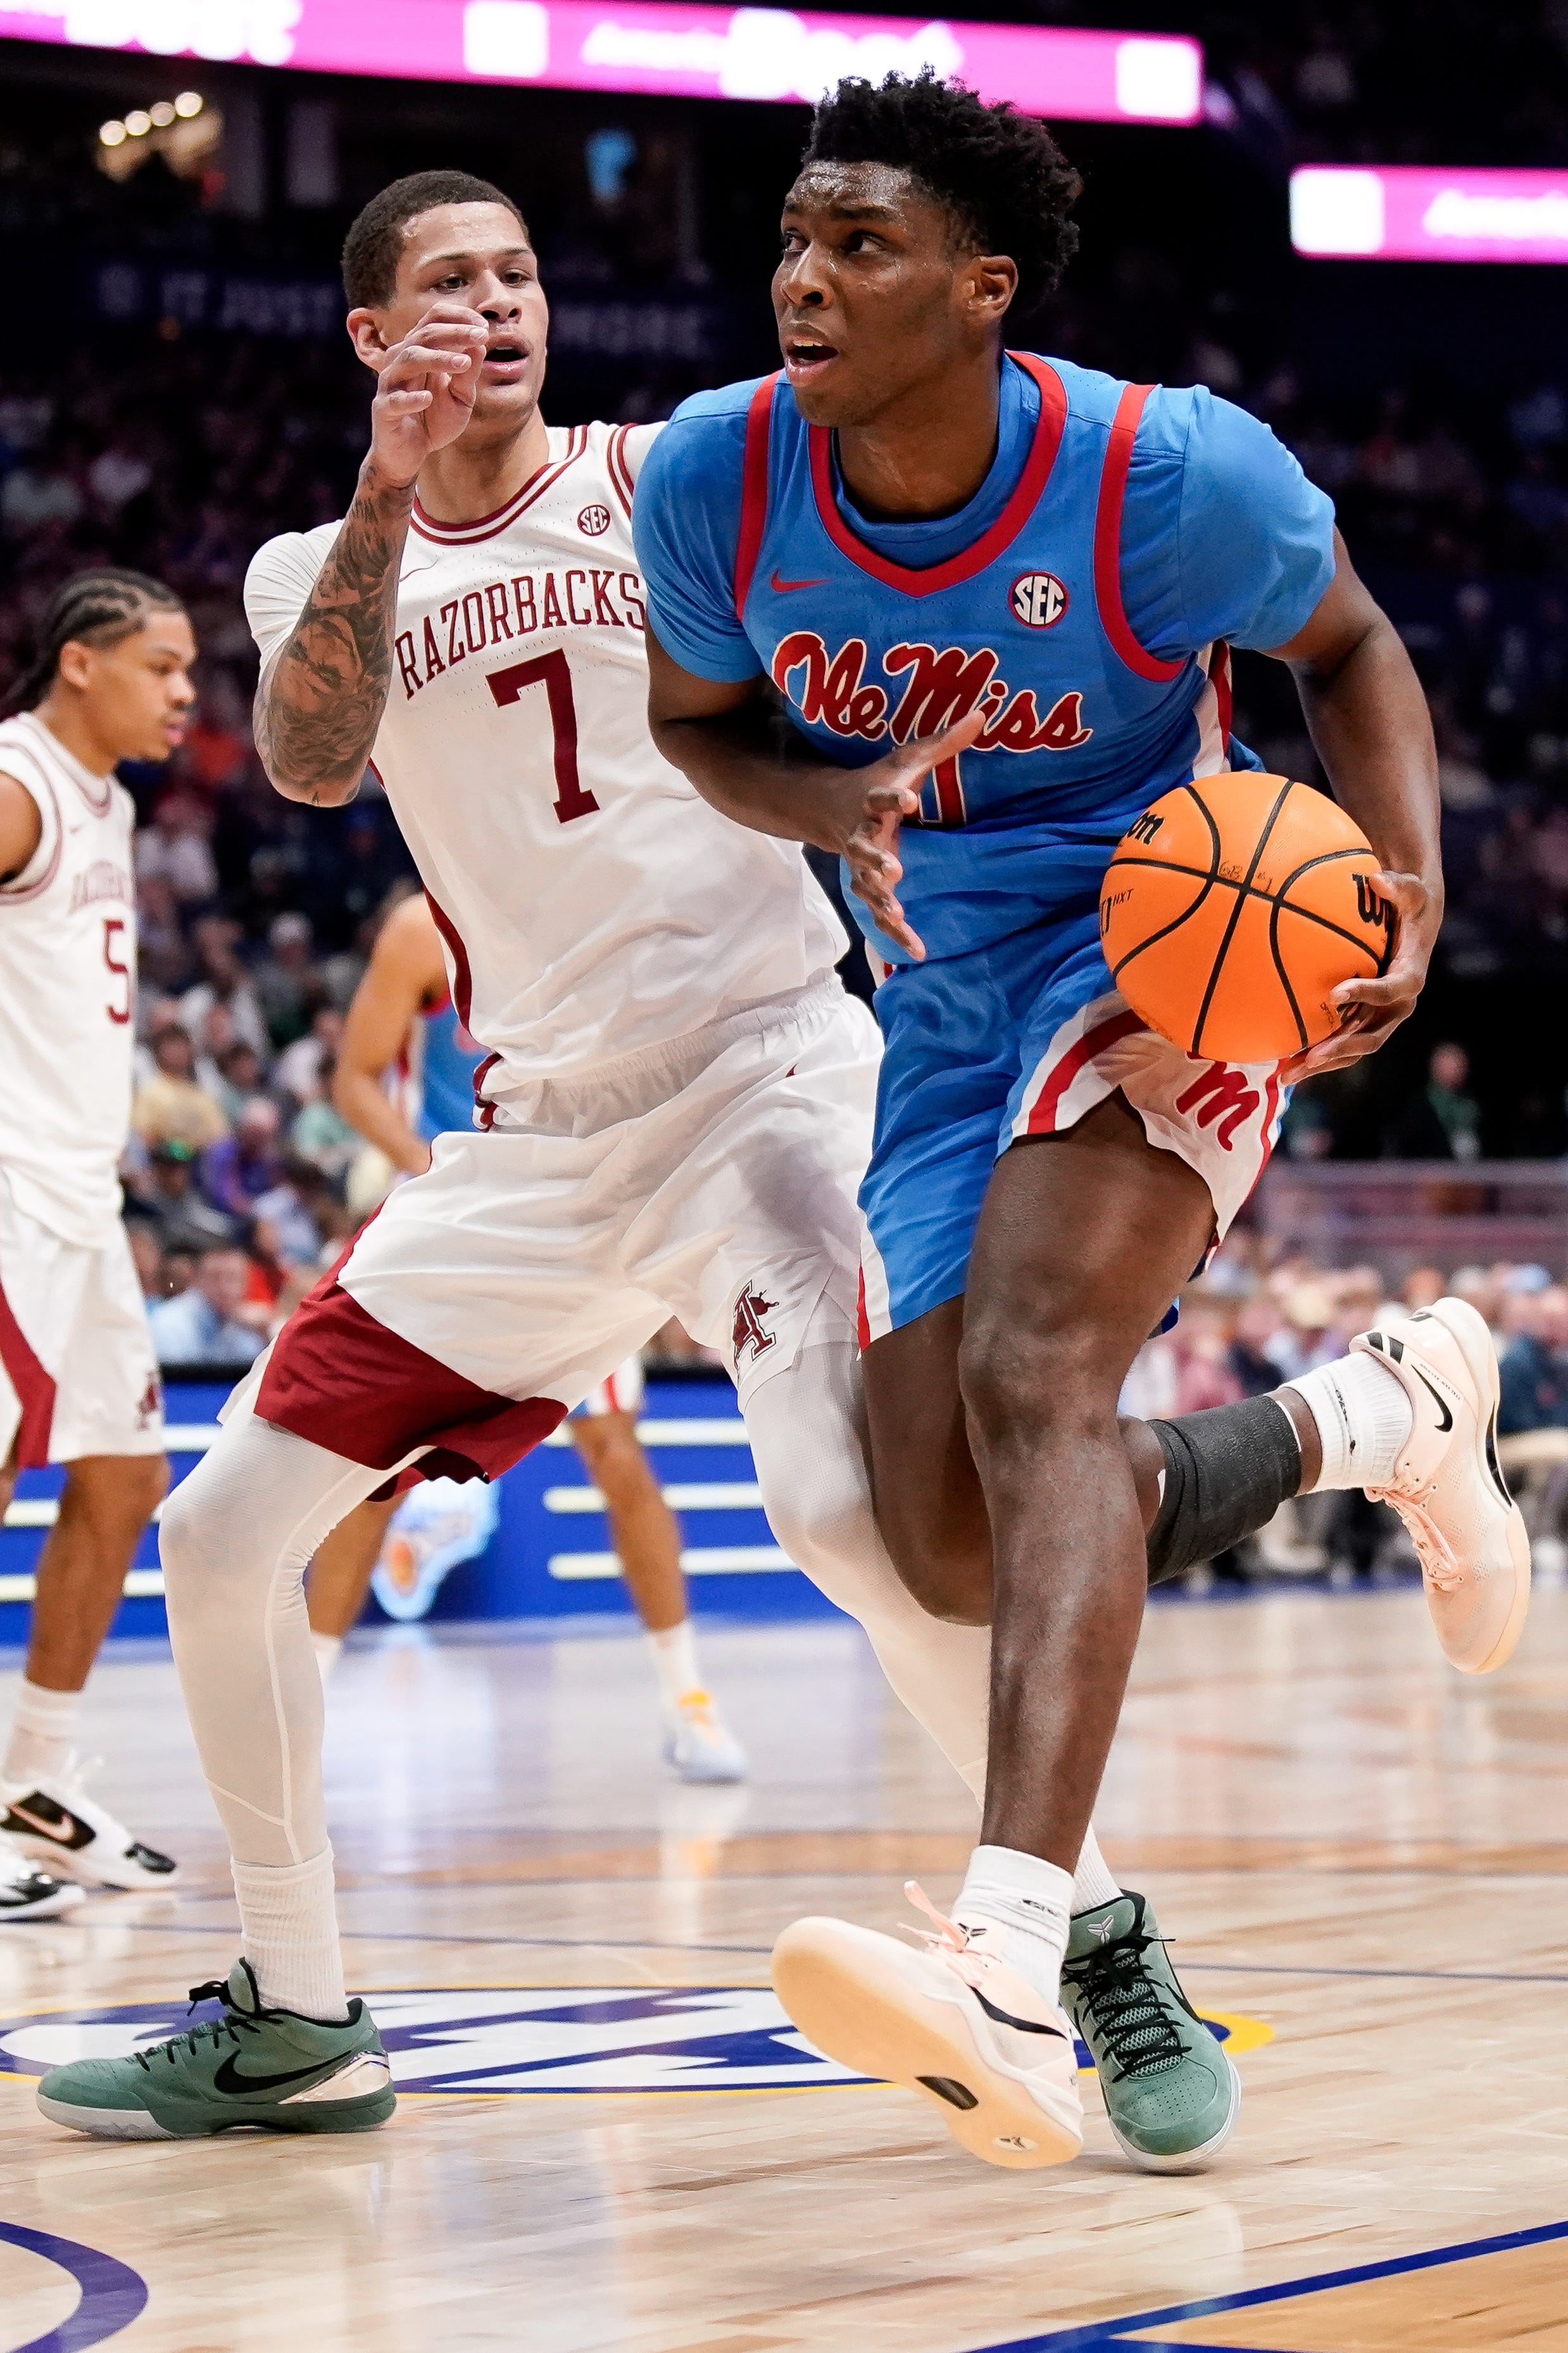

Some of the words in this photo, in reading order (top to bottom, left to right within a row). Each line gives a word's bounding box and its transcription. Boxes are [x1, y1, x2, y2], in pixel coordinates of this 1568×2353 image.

[579, 506, 608, 534] SEC
[394, 569, 645, 701] RAZORBACKS
[1012, 574, 1066, 626] SEC
[485, 648, 600, 824] 7
[771, 630, 888, 741] Ole
[882, 642, 1094, 754] Miss
[1112, 888, 1134, 907] NXT
[103, 918, 132, 1025] 5
